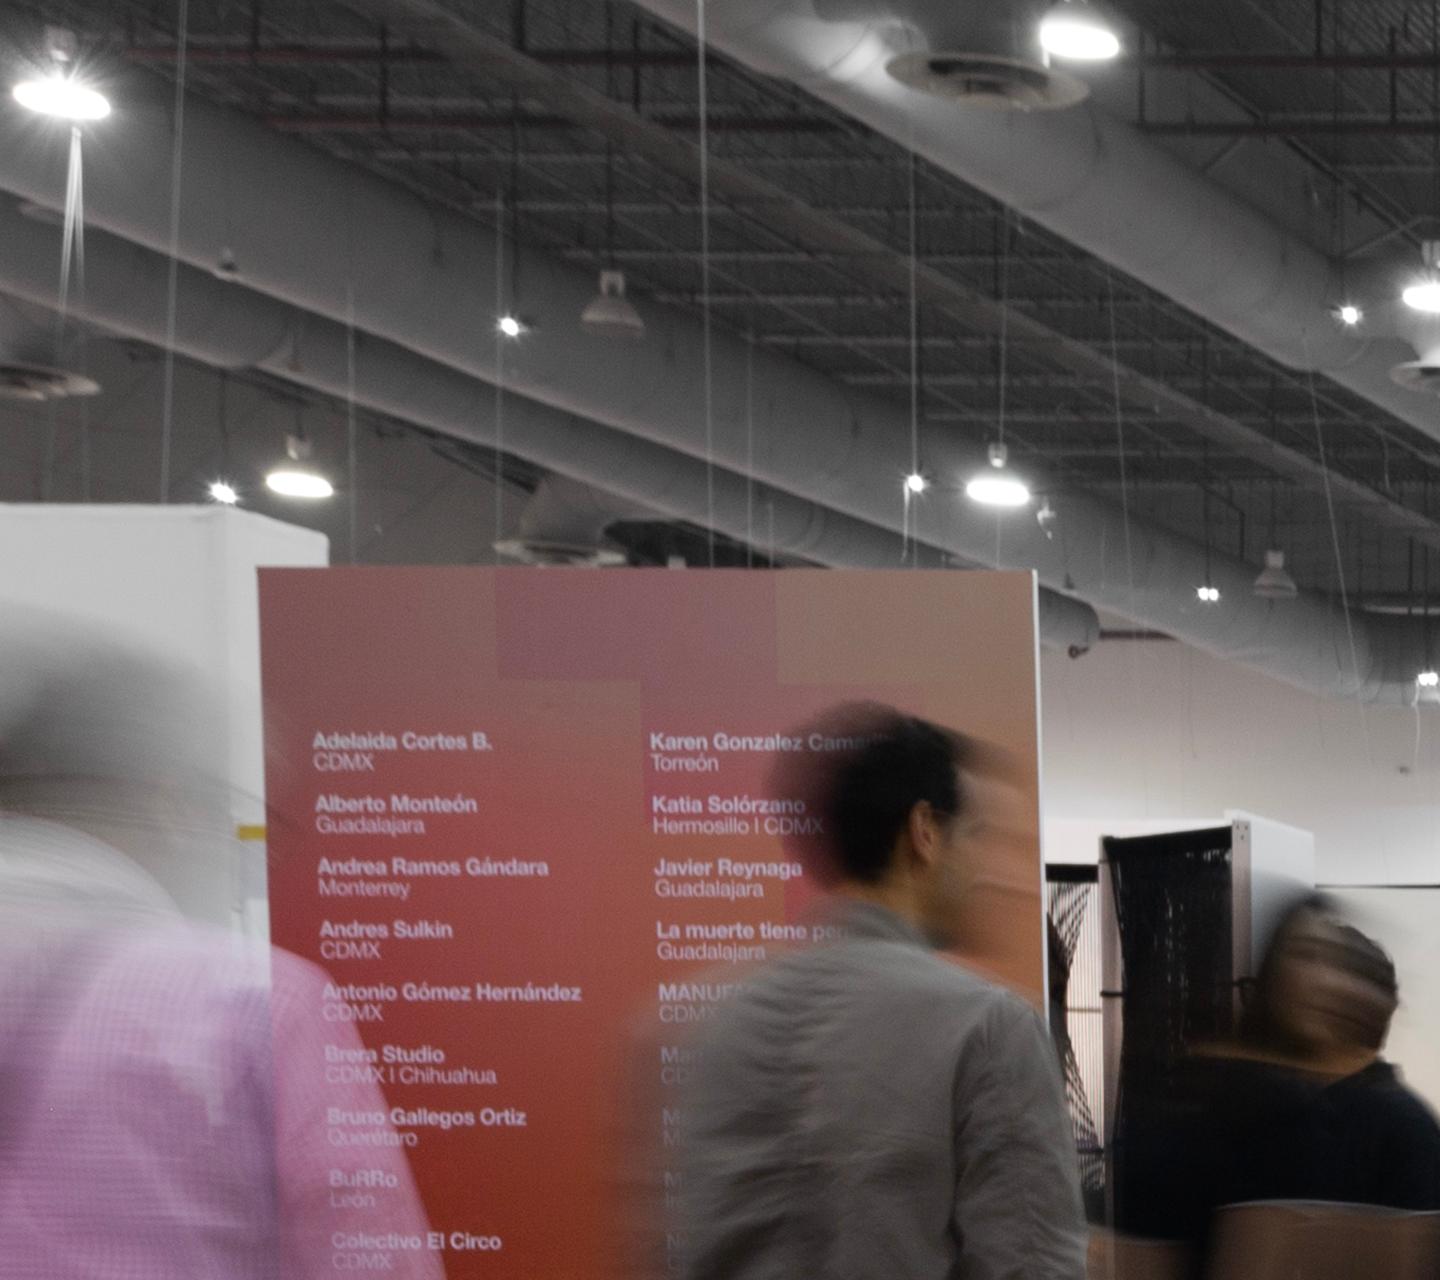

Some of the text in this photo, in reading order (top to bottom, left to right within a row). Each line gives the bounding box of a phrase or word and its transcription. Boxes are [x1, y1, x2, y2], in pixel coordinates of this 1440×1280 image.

[313, 732, 492, 750] Adelaida Cortes B.
[651, 733, 707, 750] Karen
[714, 733, 802, 751] Gonzalez
[314, 753, 374, 771] CDMX
[652, 754, 718, 771] Torreón
[315, 795, 478, 813] Alberto Monteón
[653, 796, 805, 813] Katia Solórzano
[316, 815, 425, 837] Guadalajara
[653, 817, 748, 834] Hermosillo
[764, 817, 823, 834] CDMX
[318, 857, 548, 876] Andrea Ramos Gándara
[655, 859, 802, 880] Javier Reynaga
[318, 879, 410, 899] Monterrey
[656, 879, 763, 900] Guadalajara
[320, 920, 452, 938] Andres Sulkin
[657, 922, 680, 939] La
[686, 924, 754, 939] muerte
[761, 922, 806, 939] tiene
[320, 941, 381, 959] CDMX
[657, 943, 765, 963] Guadalajara
[323, 982, 581, 1000] Antonio Gómez Hernández
[323, 1004, 382, 1021] CDMX
[383, 1045, 444, 1063] Studio
[326, 1066, 384, 1084] CDMX
[400, 1066, 496, 1084] Chihuahua
[328, 1108, 526, 1129] Bruno Gallegos Ortiz
[328, 1129, 417, 1148] Querétaro
[332, 1232, 501, 1250] Colectivo El Circo
[333, 1253, 392, 1270] CDMX
